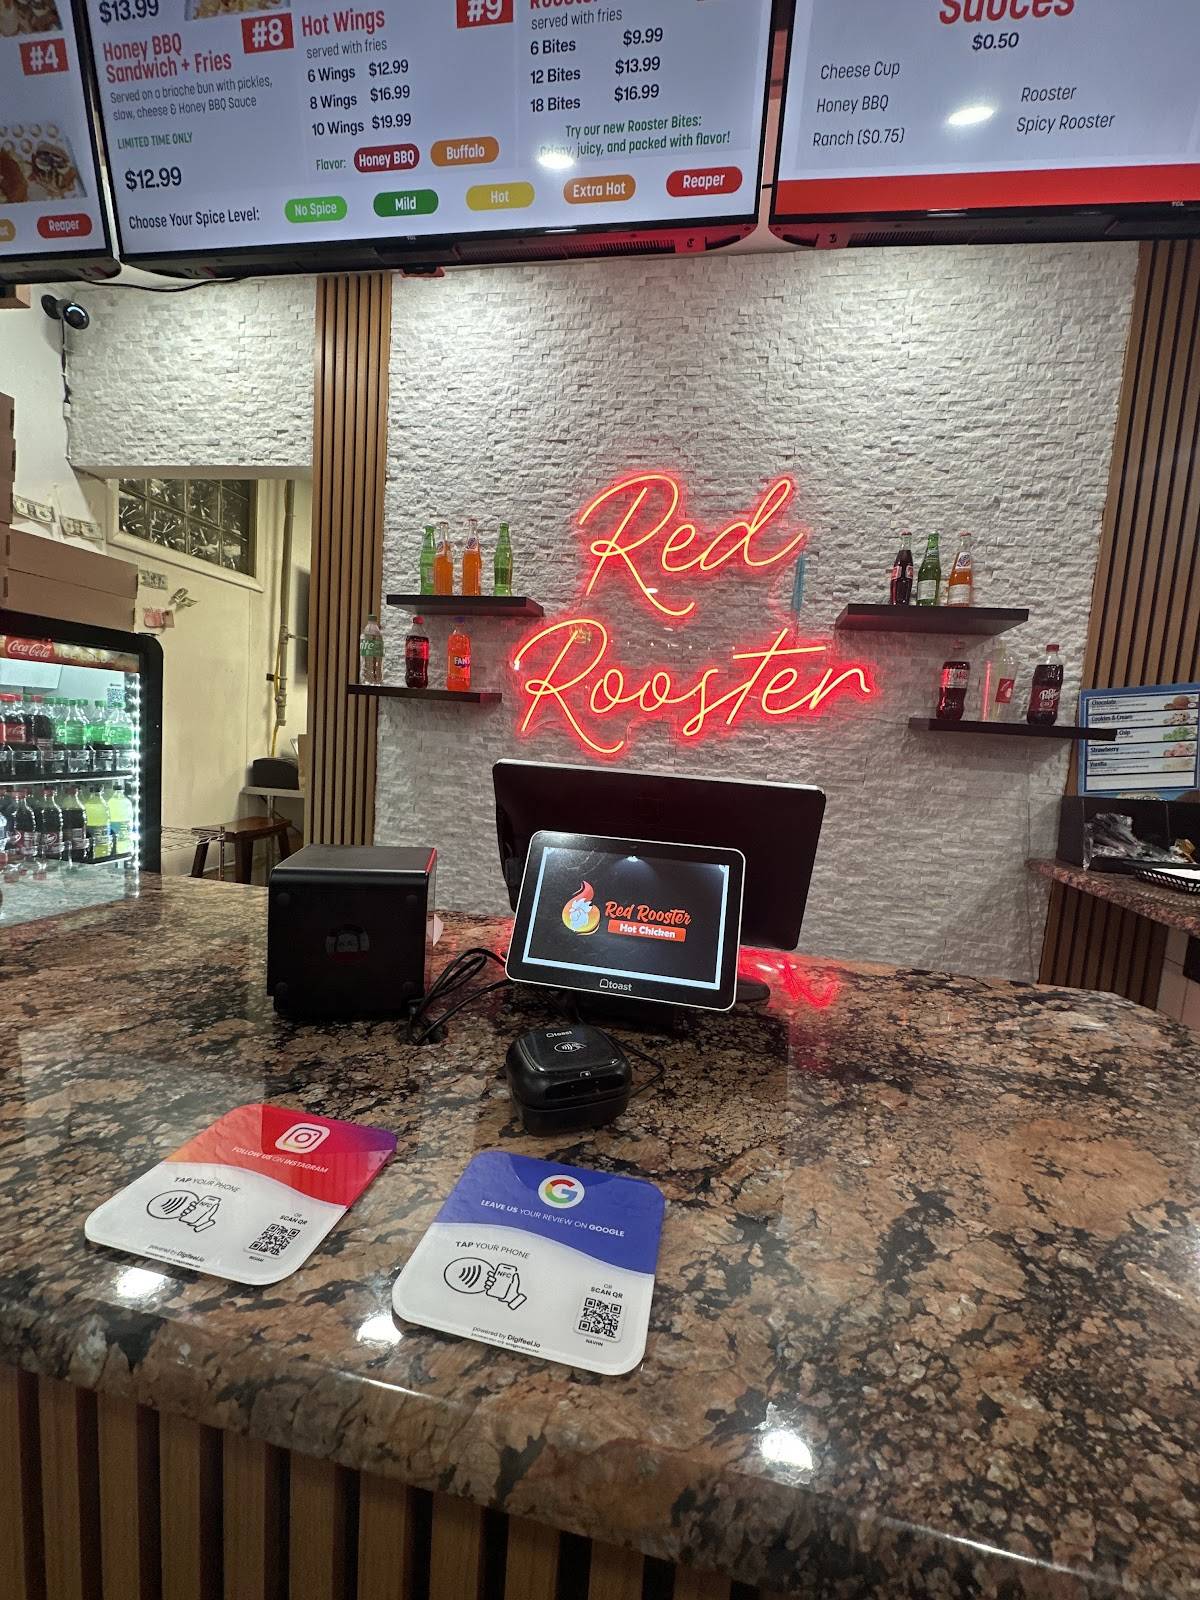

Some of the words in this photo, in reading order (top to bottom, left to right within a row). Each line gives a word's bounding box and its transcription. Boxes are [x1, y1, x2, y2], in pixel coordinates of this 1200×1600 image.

[99, 0, 160, 25] $13.99
[466, 0, 503, 22] #9
[530, 12, 568, 30] served
[570, 8, 594, 25] with
[597, 7, 623, 23] fries
[250, 18, 286, 49] #8
[302, 13, 329, 37] Hot
[334, 8, 386, 36] Wings
[103, 40, 148, 62] Honey
[151, 32, 183, 56] BBQ
[306, 42, 339, 60] served
[340, 42, 363, 56] with
[364, 38, 388, 53] fries
[530, 42, 539, 56] 6
[541, 37, 577, 54] Bites
[622, 26, 664, 48] $9.99
[971, 31, 1019, 51] $0.50
[28, 42, 60, 74] #4
[106, 56, 178, 84] Sandwich
[181, 58, 190, 72] +
[194, 50, 233, 74] Fries
[307, 70, 316, 83] 6
[317, 65, 356, 83] Wings
[368, 58, 410, 78] $12.99
[530, 70, 544, 84] 12
[547, 66, 581, 82] Bites
[614, 55, 662, 76] $13.99
[820, 62, 870, 80] Cheese
[874, 59, 901, 78] Cup
[110, 89, 142, 105] Served
[141, 90, 154, 102] on
[154, 89, 162, 101] a
[162, 83, 197, 99] brioche
[197, 82, 214, 97] bun
[216, 78, 237, 95] with
[238, 73, 273, 95] pickles,
[309, 97, 318, 110] 8
[320, 92, 358, 111] Wings
[370, 85, 411, 105] $16.99
[530, 98, 545, 113] 18
[547, 95, 581, 111] Bites
[613, 83, 661, 103] $16.99
[1020, 85, 1078, 103] Rooster
[112, 106, 136, 122] slaw,
[136, 102, 169, 119] cheese
[169, 100, 178, 115] &
[178, 98, 208, 116] Honey
[208, 95, 228, 112] BBQ
[228, 94, 258, 110] Sauce
[815, 96, 858, 115] Honey
[861, 94, 890, 113] BBQ
[311, 122, 325, 136] 10
[327, 118, 366, 137] Wings
[371, 112, 413, 132] $19.99
[565, 124, 581, 140] Try
[583, 122, 600, 136] our
[603, 121, 626, 135] new
[627, 116, 669, 133] Rooster
[671, 113, 703, 130] Bites:
[1016, 117, 1055, 134] Spicy
[1059, 112, 1116, 131] Rooster
[117, 138, 150, 150] LIMITED
[151, 135, 172, 147] TIME
[172, 131, 194, 146] ONLY
[577, 138, 604, 158] juicy,
[606, 137, 627, 153] and
[628, 132, 668, 153] packed
[669, 129, 694, 147] with
[695, 130, 731, 147] flavor!
[812, 130, 855, 147] Ranch
[857, 127, 905, 146] ($0.75)
[359, 153, 392, 169] Honey
[393, 149, 416, 166] BBQ
[446, 143, 486, 161] Buffalo
[316, 158, 347, 172] Flavor:
[125, 166, 183, 192] $12.99
[573, 184, 604, 197] Extra
[606, 181, 627, 195] Hot
[682, 172, 726, 192] Reaper
[395, 196, 417, 211] Mild
[490, 190, 510, 204] Hot
[129, 213, 167, 231] Choose
[168, 211, 194, 227] Your
[194, 209, 227, 227] Spice
[228, 207, 261, 222] Level:
[294, 205, 309, 217] No
[309, 203, 337, 217] Spice
[48, 220, 80, 233] Reaper
[578, 472, 806, 617] Red
[512, 617, 873, 755] Rooster
[605, 900, 635, 919] Red
[636, 904, 692, 925] Rooster
[619, 923, 638, 933] Hot
[638, 925, 676, 939] Chicken
[608, 979, 633, 992] toast
[231, 1146, 261, 1158] FOLLOW
[284, 1158, 329, 1173] INSTAGRAM
[192, 1177, 215, 1186] YOUR
[215, 1182, 240, 1193] PHONE
[279, 1214, 298, 1223] SCAN
[480, 1199, 506, 1211] LEAVE
[506, 1204, 519, 1213] US
[519, 1208, 542, 1219] YOUR
[542, 1213, 574, 1225] REVIEW
[574, 1220, 588, 1229] ON
[588, 1223, 626, 1238] GOOGLE
[455, 1240, 474, 1249] TAP
[475, 1242, 500, 1252] YOUR
[500, 1246, 531, 1260] PHONE
[496, 1270, 512, 1279] NFC
[590, 1286, 611, 1296] SCAN
[611, 1291, 623, 1300] QR
[472, 1326, 500, 1338] powered
[499, 1331, 508, 1341] by
[507, 1334, 541, 1348] Digifeel.io
